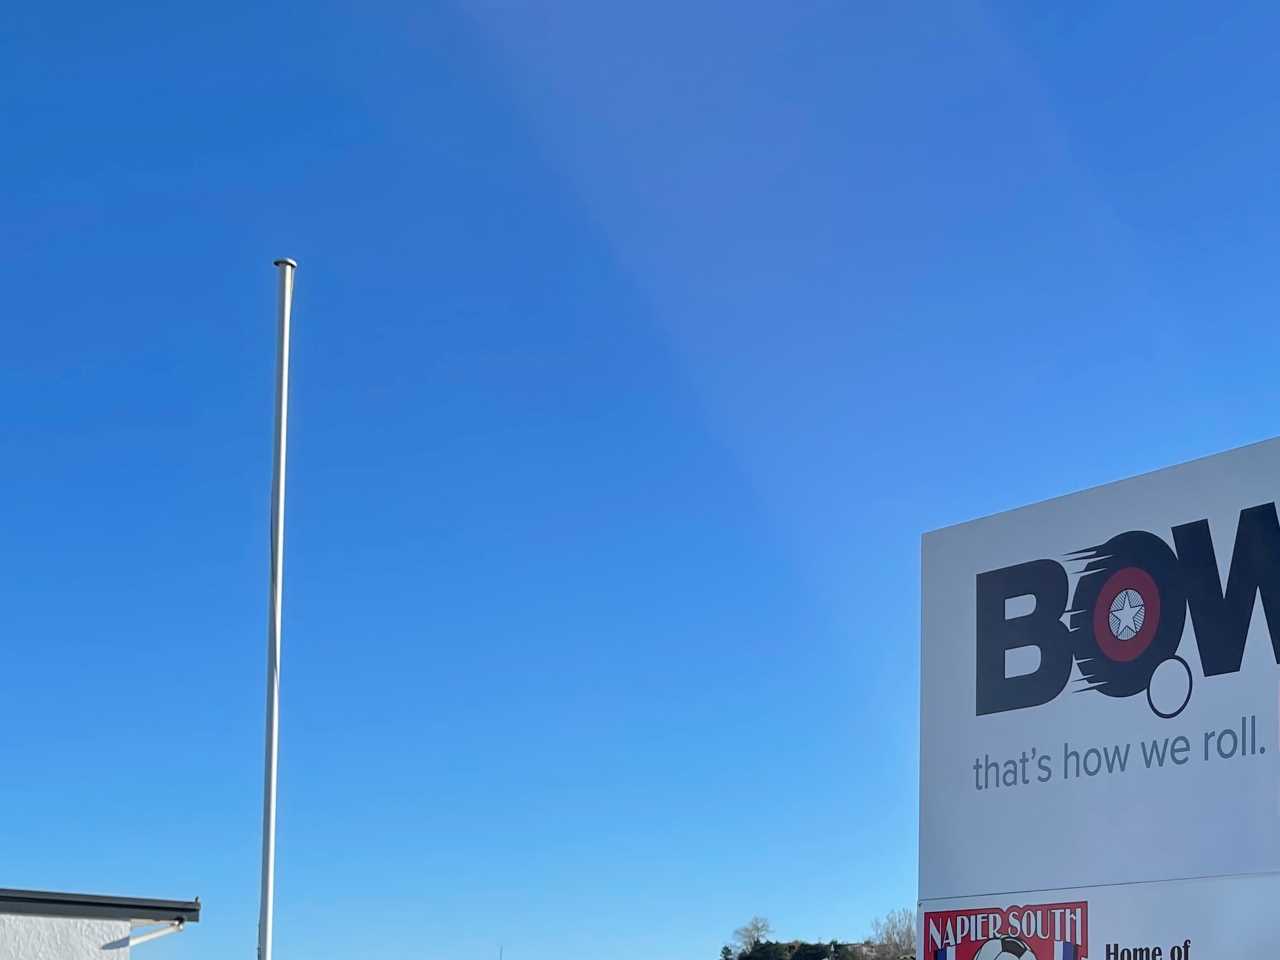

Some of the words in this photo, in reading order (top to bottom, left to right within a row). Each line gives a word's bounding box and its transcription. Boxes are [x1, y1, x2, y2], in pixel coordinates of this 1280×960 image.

[973, 747, 1052, 790] that's
[1063, 742, 1131, 779] how
[1141, 735, 1191, 769] we
[1203, 715, 1266, 761] roll.
[929, 913, 1001, 953] NAPIER
[1008, 907, 1082, 946] SOUTH
